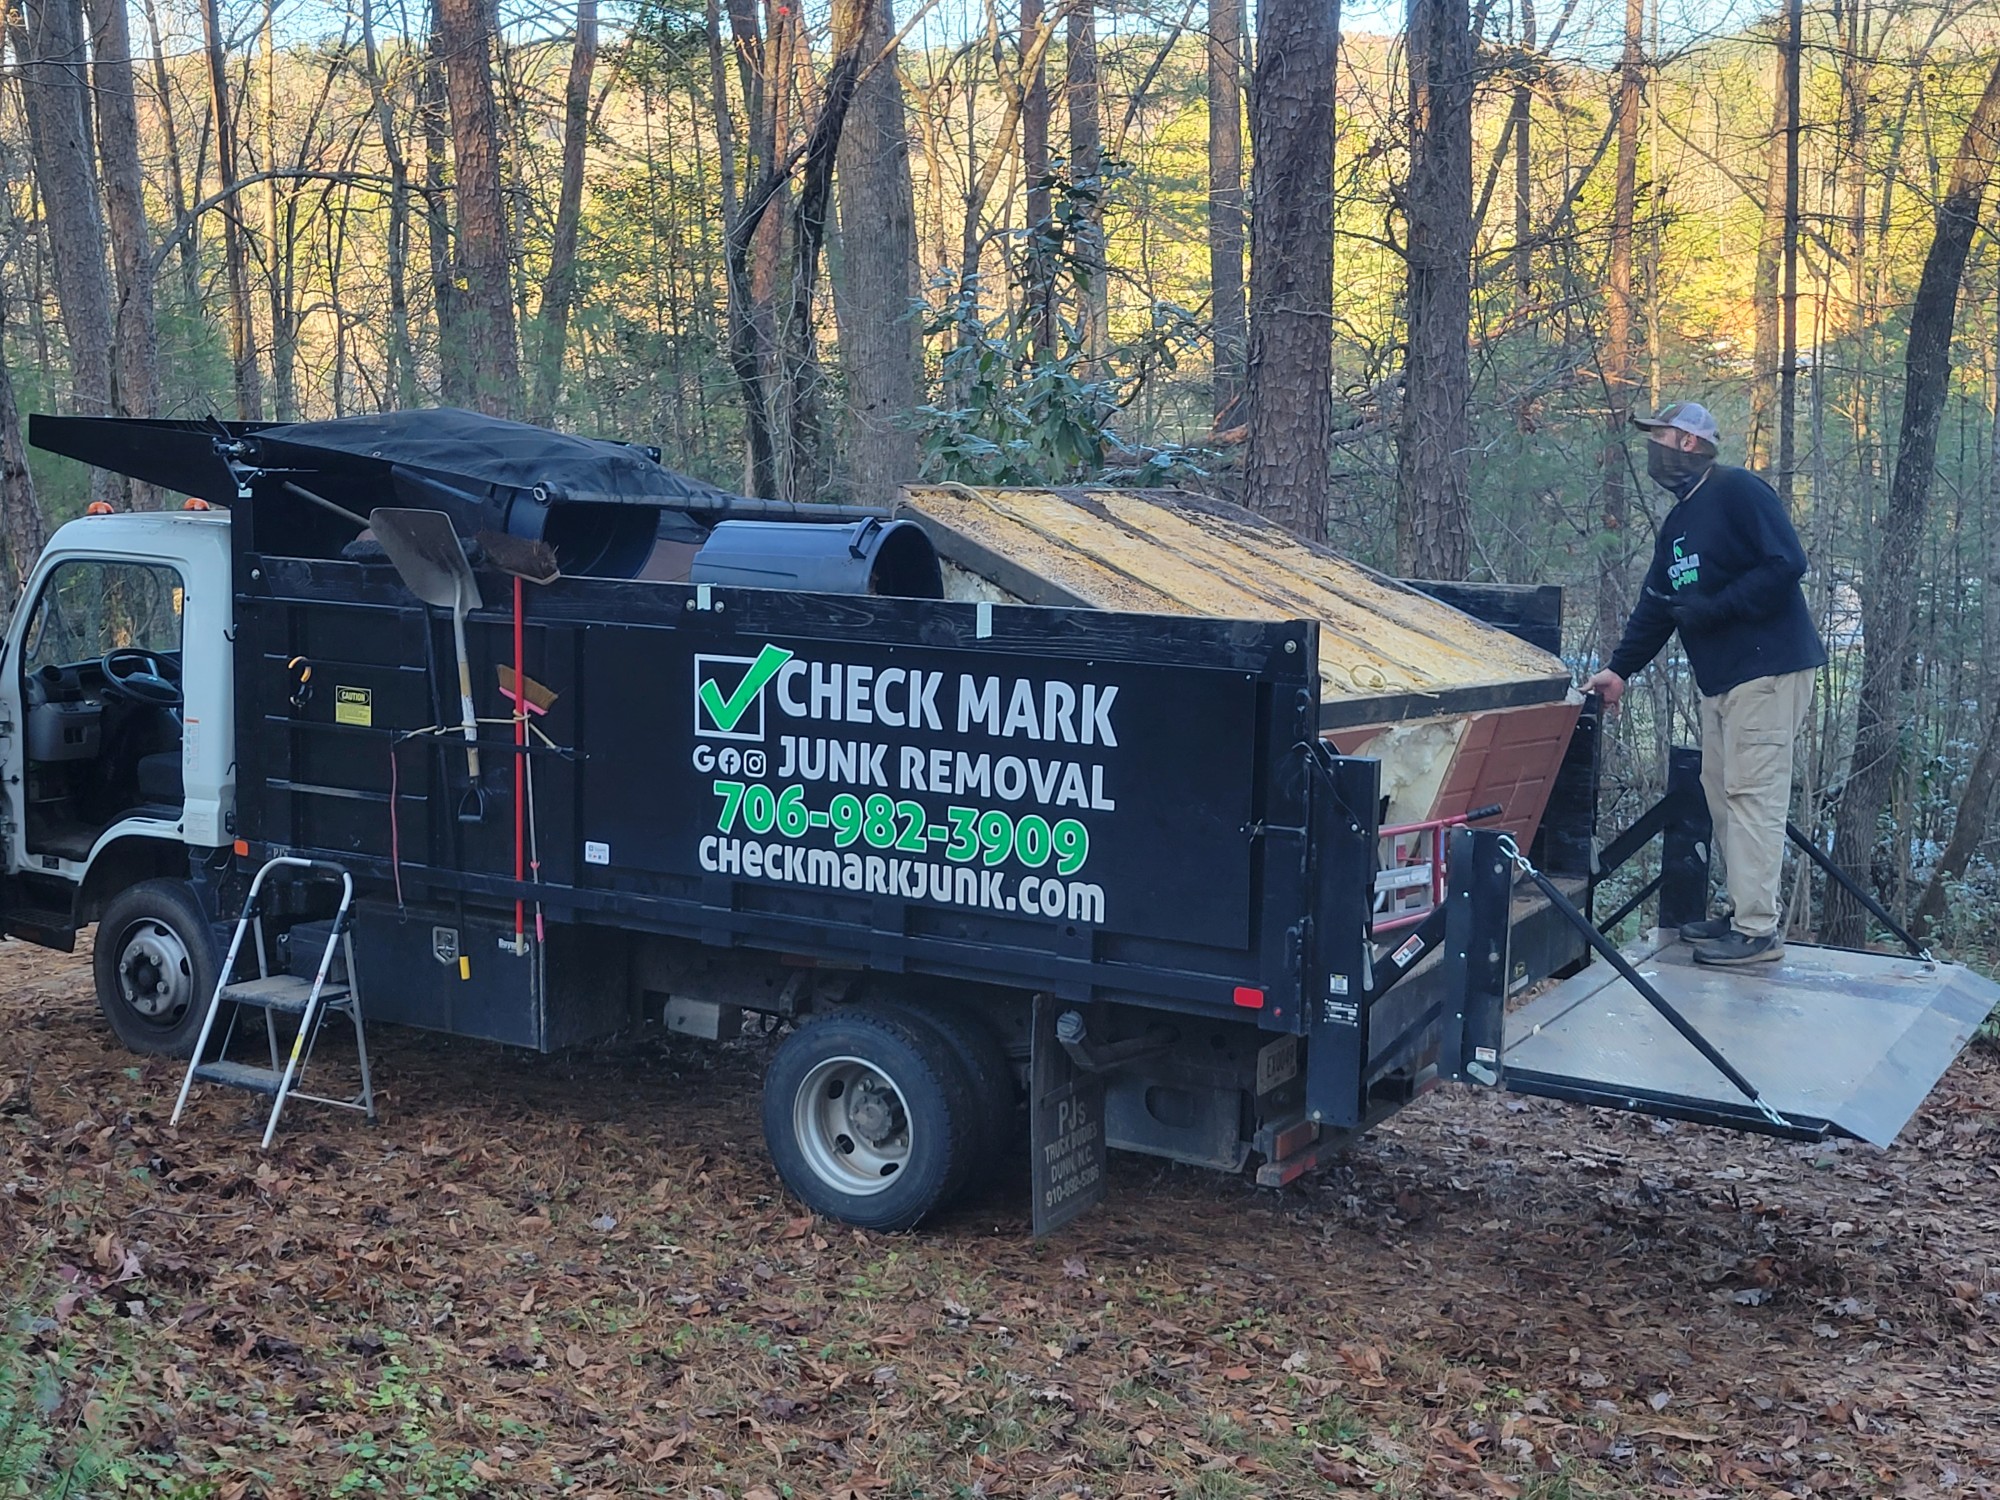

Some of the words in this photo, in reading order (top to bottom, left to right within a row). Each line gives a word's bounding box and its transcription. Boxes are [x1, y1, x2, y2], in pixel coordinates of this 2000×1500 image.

[341, 691, 366, 702] CAUTION
[777, 659, 943, 730] CHECK
[957, 674, 1119, 747] MARK
[778, 736, 888, 787] JUNK
[900, 746, 1115, 811] REMOVAL
[713, 780, 1089, 875] 706-982-3909
[1044, 1134, 1071, 1164] TRUCK
